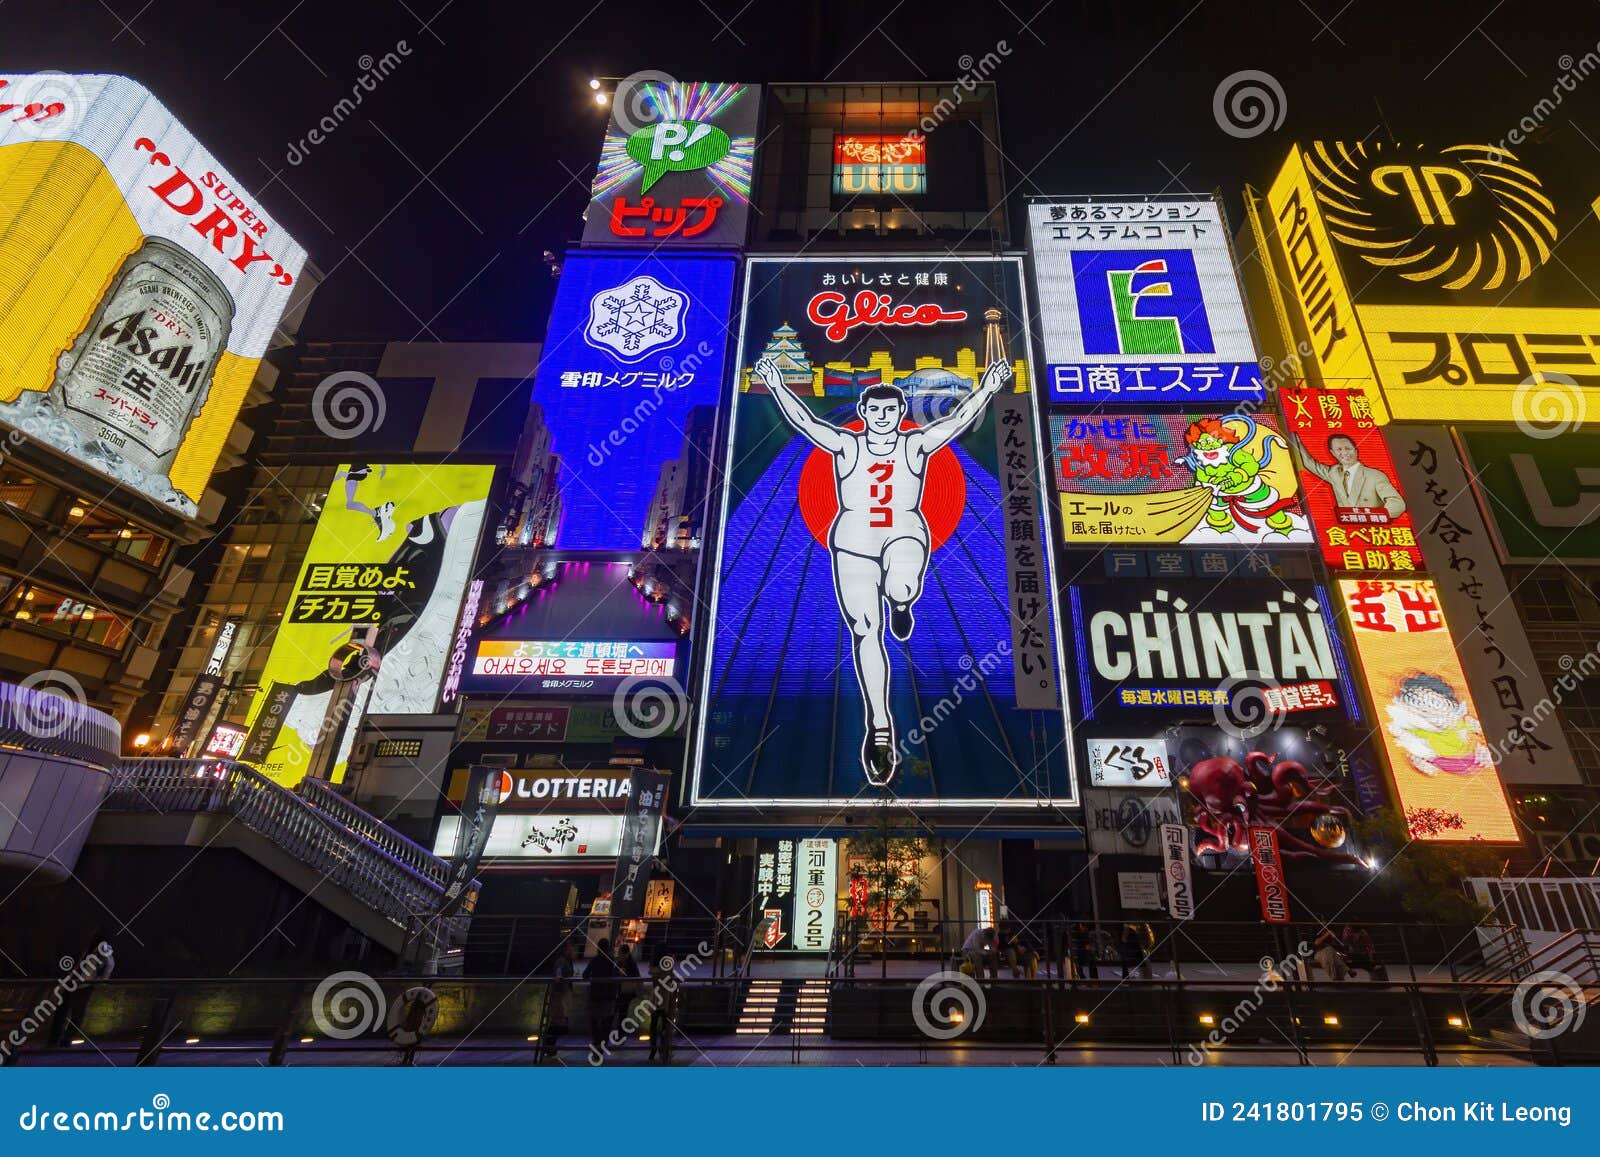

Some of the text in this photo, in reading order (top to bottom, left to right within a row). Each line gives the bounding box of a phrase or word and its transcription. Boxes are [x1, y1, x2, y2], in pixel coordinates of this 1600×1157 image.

[200, 172, 267, 239] SUPER
[608, 197, 723, 238] ピップ
[1050, 205, 1201, 220] 夢あるマンション
[1053, 225, 1207, 240] エステムコート
[822, 272, 949, 286] おいしさと健康
[1279, 186, 1348, 364] プロミス
[807, 290, 968, 342] Glico
[100, 310, 206, 393] Asahi
[1387, 331, 1600, 388] プロミ
[122, 367, 156, 401] 生
[560, 371, 695, 390] 雪印メグミルク
[1054, 365, 1264, 394] 日商エステム
[94, 387, 158, 430] スーパードライ
[98, 426, 127, 449] 350ml
[1064, 417, 1158, 441] かぜに
[1060, 443, 1174, 480] 改源
[867, 460, 896, 528] グリコ
[1069, 501, 1133, 516] エールの
[1071, 522, 1147, 536] 風を届けたい
[1326, 526, 1416, 547] 食べ放題
[1002, 408, 1049, 689] みんなに笑顔を届けたい。
[1342, 550, 1416, 571] 自助餐
[307, 566, 416, 589] 目覚めよ、
[297, 594, 382, 620] チカラ。
[1409, 440, 1554, 765] 力を合わせよう日本
[1090, 589, 1338, 680] CHINTAI
[513, 642, 644, 658] ようこそ道頓堀へ
[483, 659, 667, 676] 어서오세요 도톤보리에
[542, 679, 594, 689] 雪印メグミルク
[1121, 689, 1230, 706] 毎週水曜日発売
[1264, 686, 1304, 712] 賃貸
[1104, 745, 1154, 780] くくる
[517, 778, 632, 798] LOTTERIA
